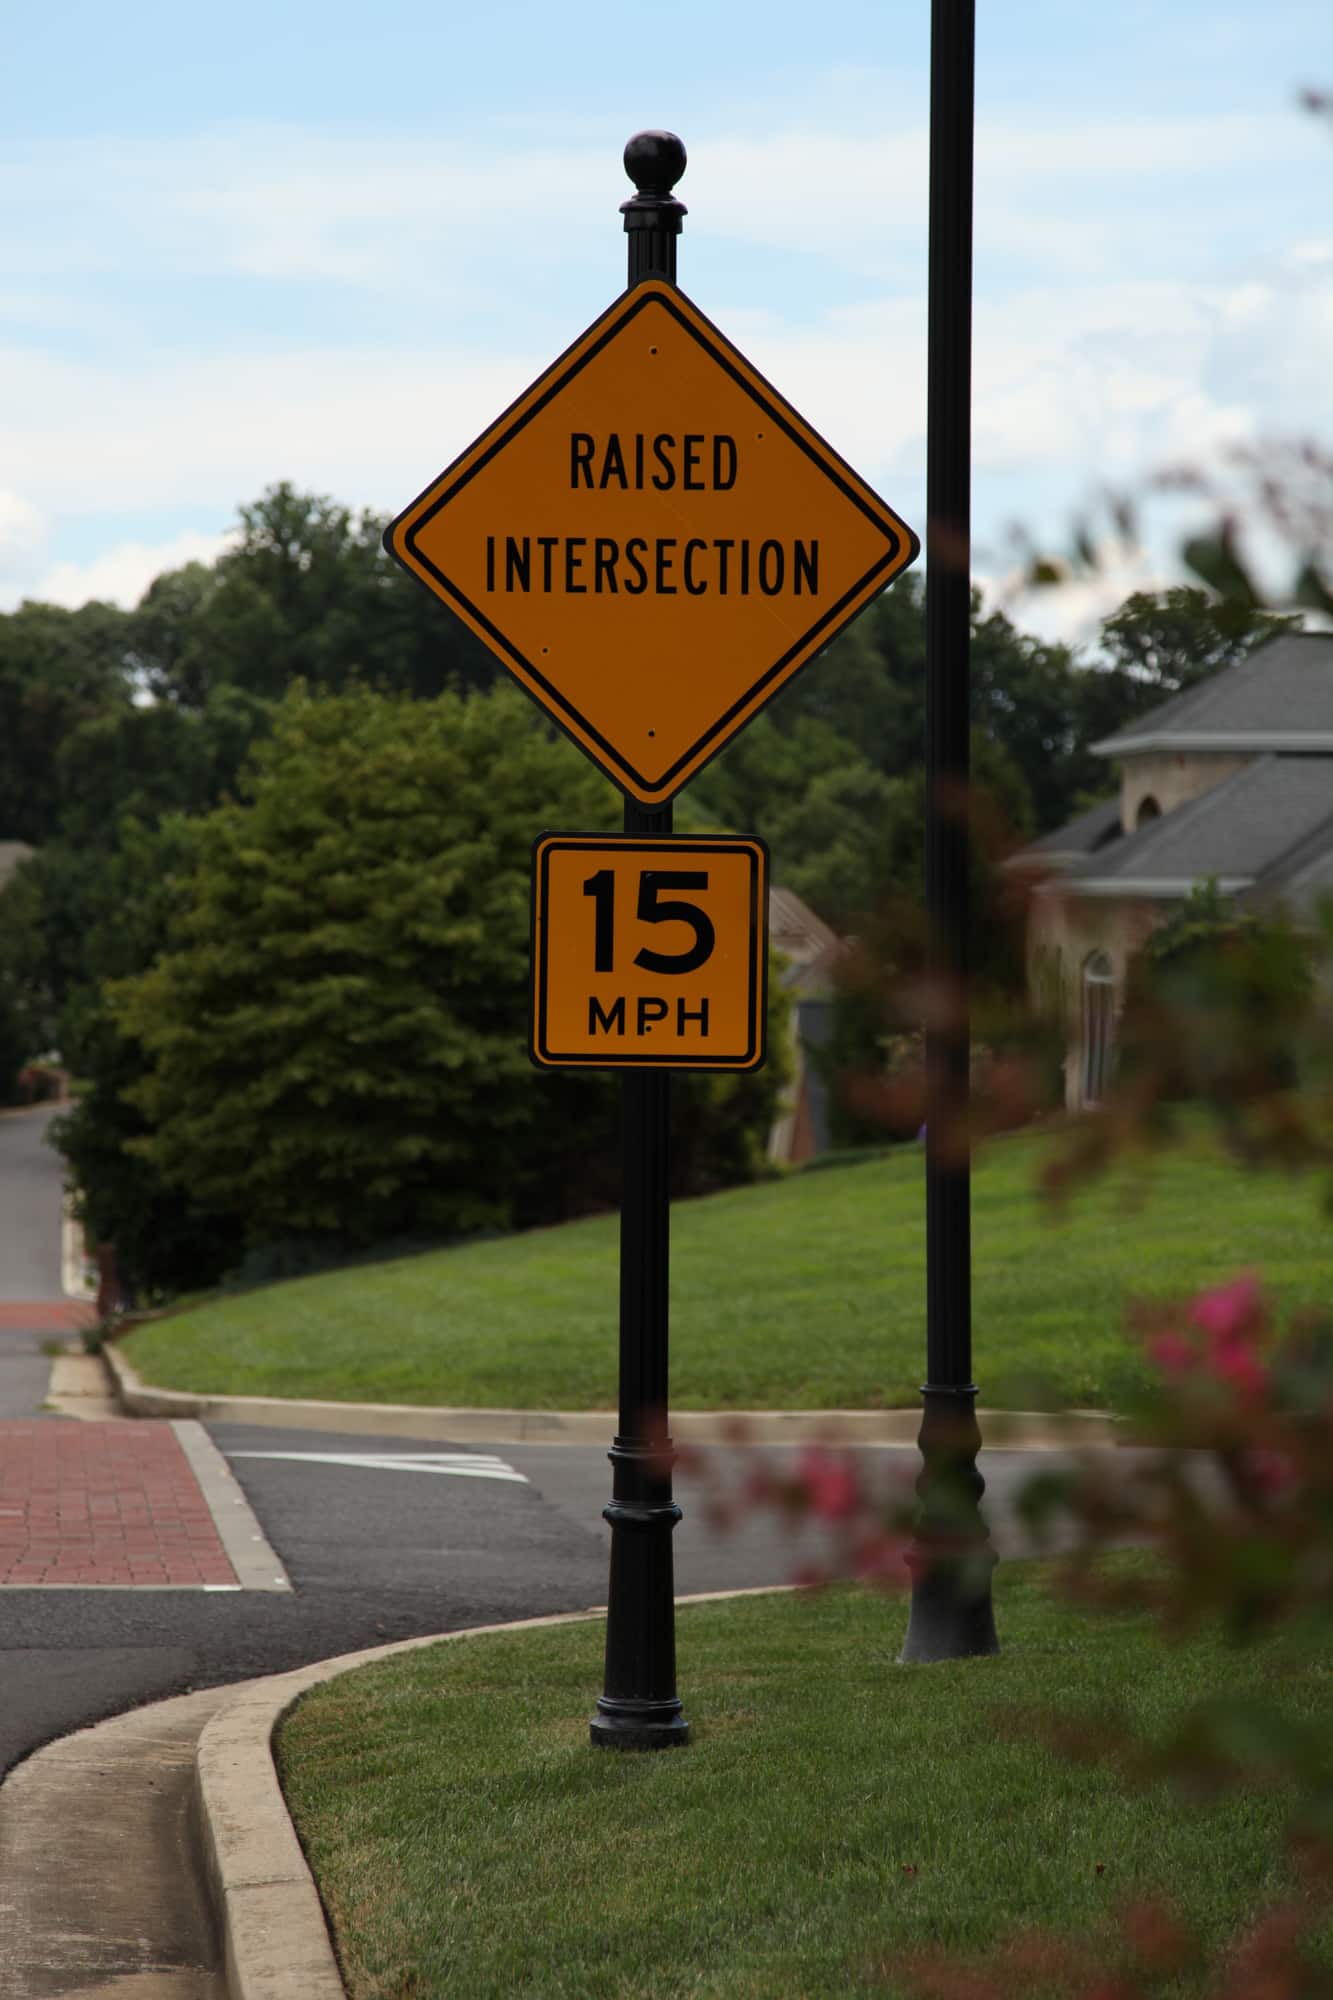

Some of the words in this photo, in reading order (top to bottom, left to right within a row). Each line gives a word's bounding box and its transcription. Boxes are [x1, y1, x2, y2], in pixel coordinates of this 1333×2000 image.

[570, 432, 738, 491] RAISED
[486, 535, 820, 597] INTERSECTION
[583, 869, 715, 975] 15
[588, 996, 709, 1037] MPH
